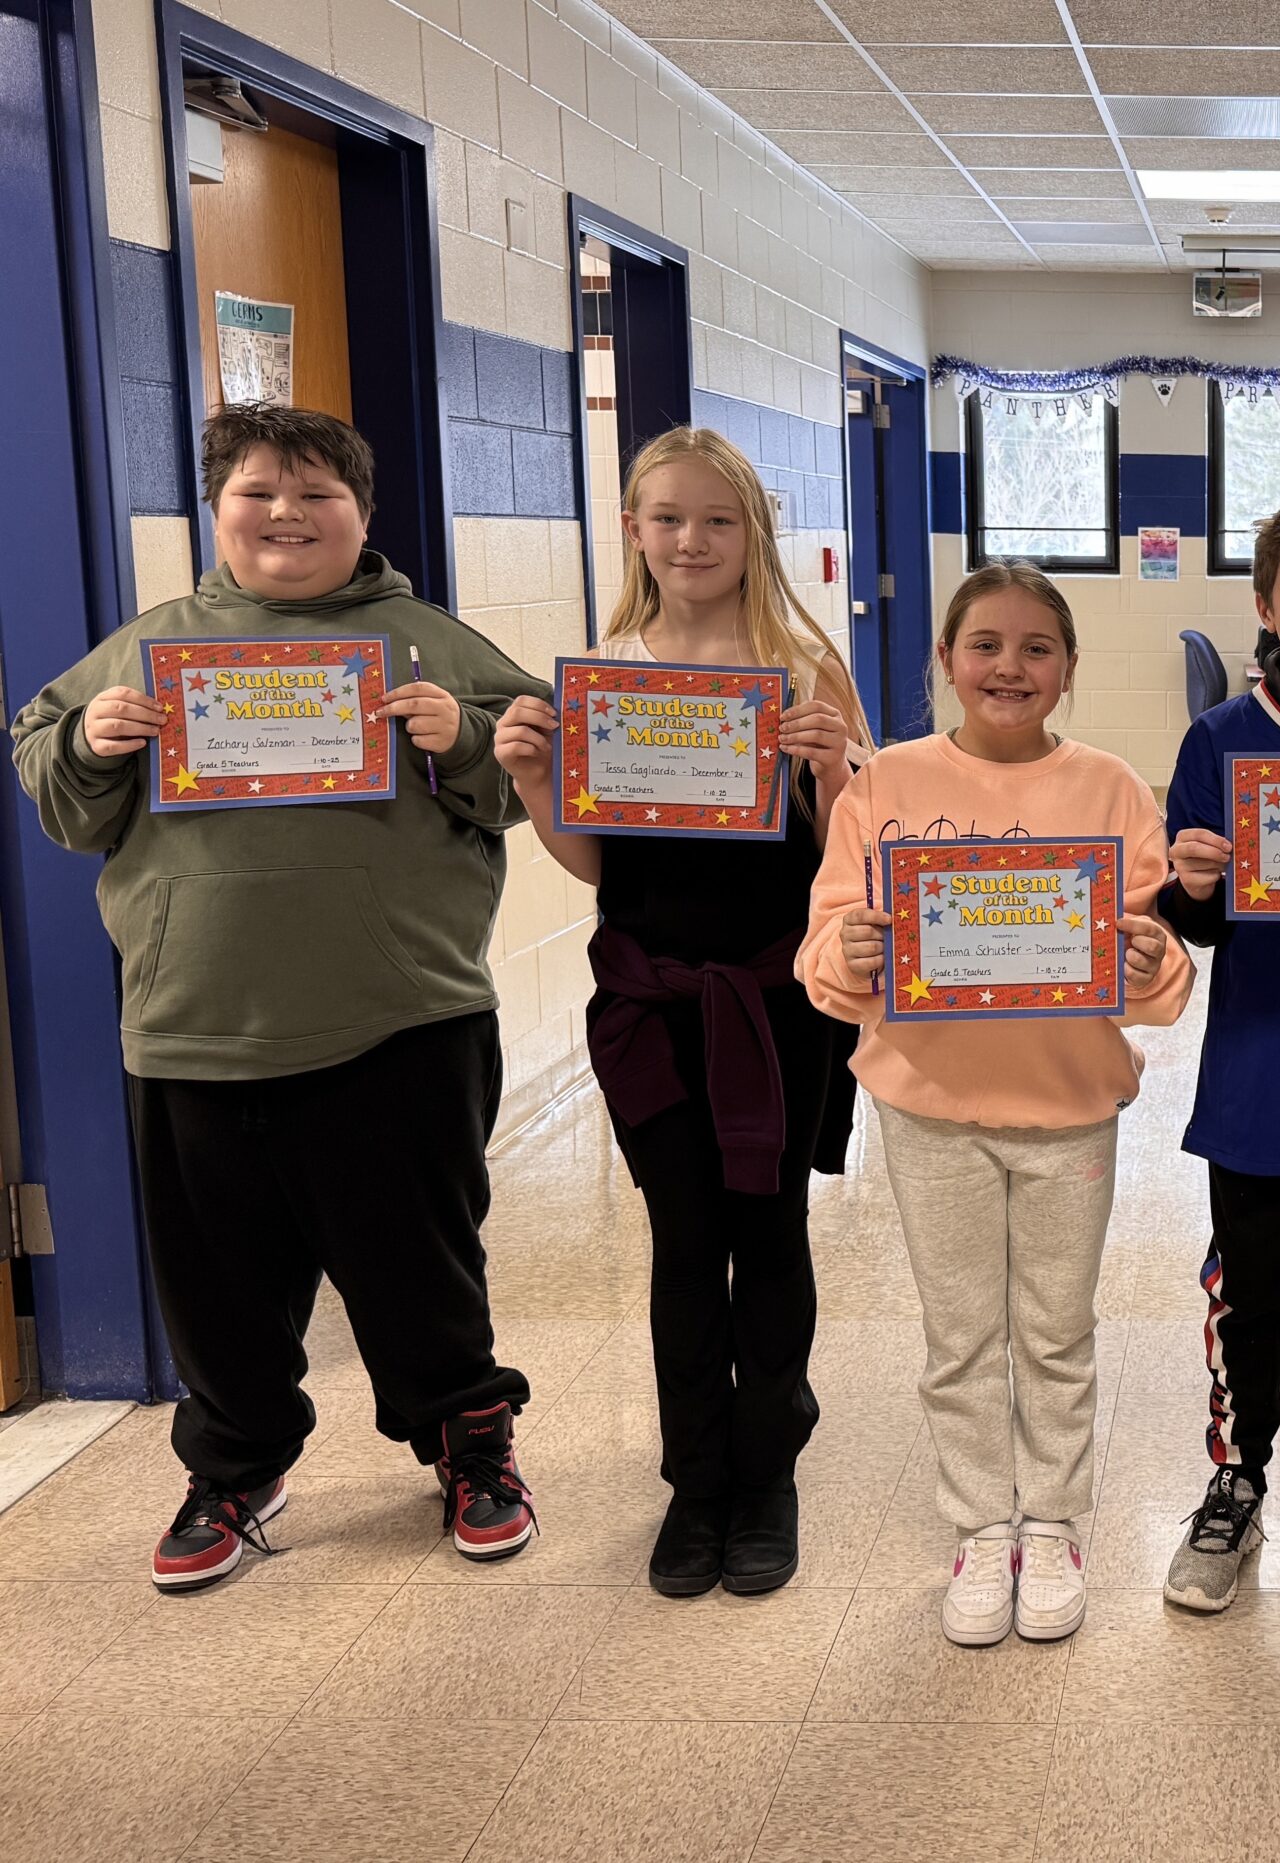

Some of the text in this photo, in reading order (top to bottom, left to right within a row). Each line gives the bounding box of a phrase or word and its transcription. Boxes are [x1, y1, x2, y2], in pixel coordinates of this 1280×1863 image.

[958, 381, 1117, 418] PANTHER
[215, 669, 328, 690] Student
[250, 689, 295, 700] of the
[226, 699, 323, 720] Month
[618, 696, 726, 718] Student
[651, 717, 694, 729] of the
[208, 738, 249, 753] Zachary
[253, 737, 295, 748] Salzman
[312, 737, 347, 746] December
[627, 727, 720, 748] Month
[197, 760, 259, 769] Grade 5 Teachers
[601, 762, 626, 774] Tessa
[631, 764, 675, 777] Gagliardo
[691, 767, 728, 777] December
[594, 784, 614, 792] Grade
[622, 785, 654, 793] Teachers
[951, 874, 1060, 894] Student
[983, 895, 1028, 906] of the
[959, 905, 1054, 926] Month
[939, 947, 970, 957] Emma
[976, 943, 1021, 956] Schuster
[1036, 944, 1076, 954] December
[931, 968, 991, 977] Grade 5 Teachers
